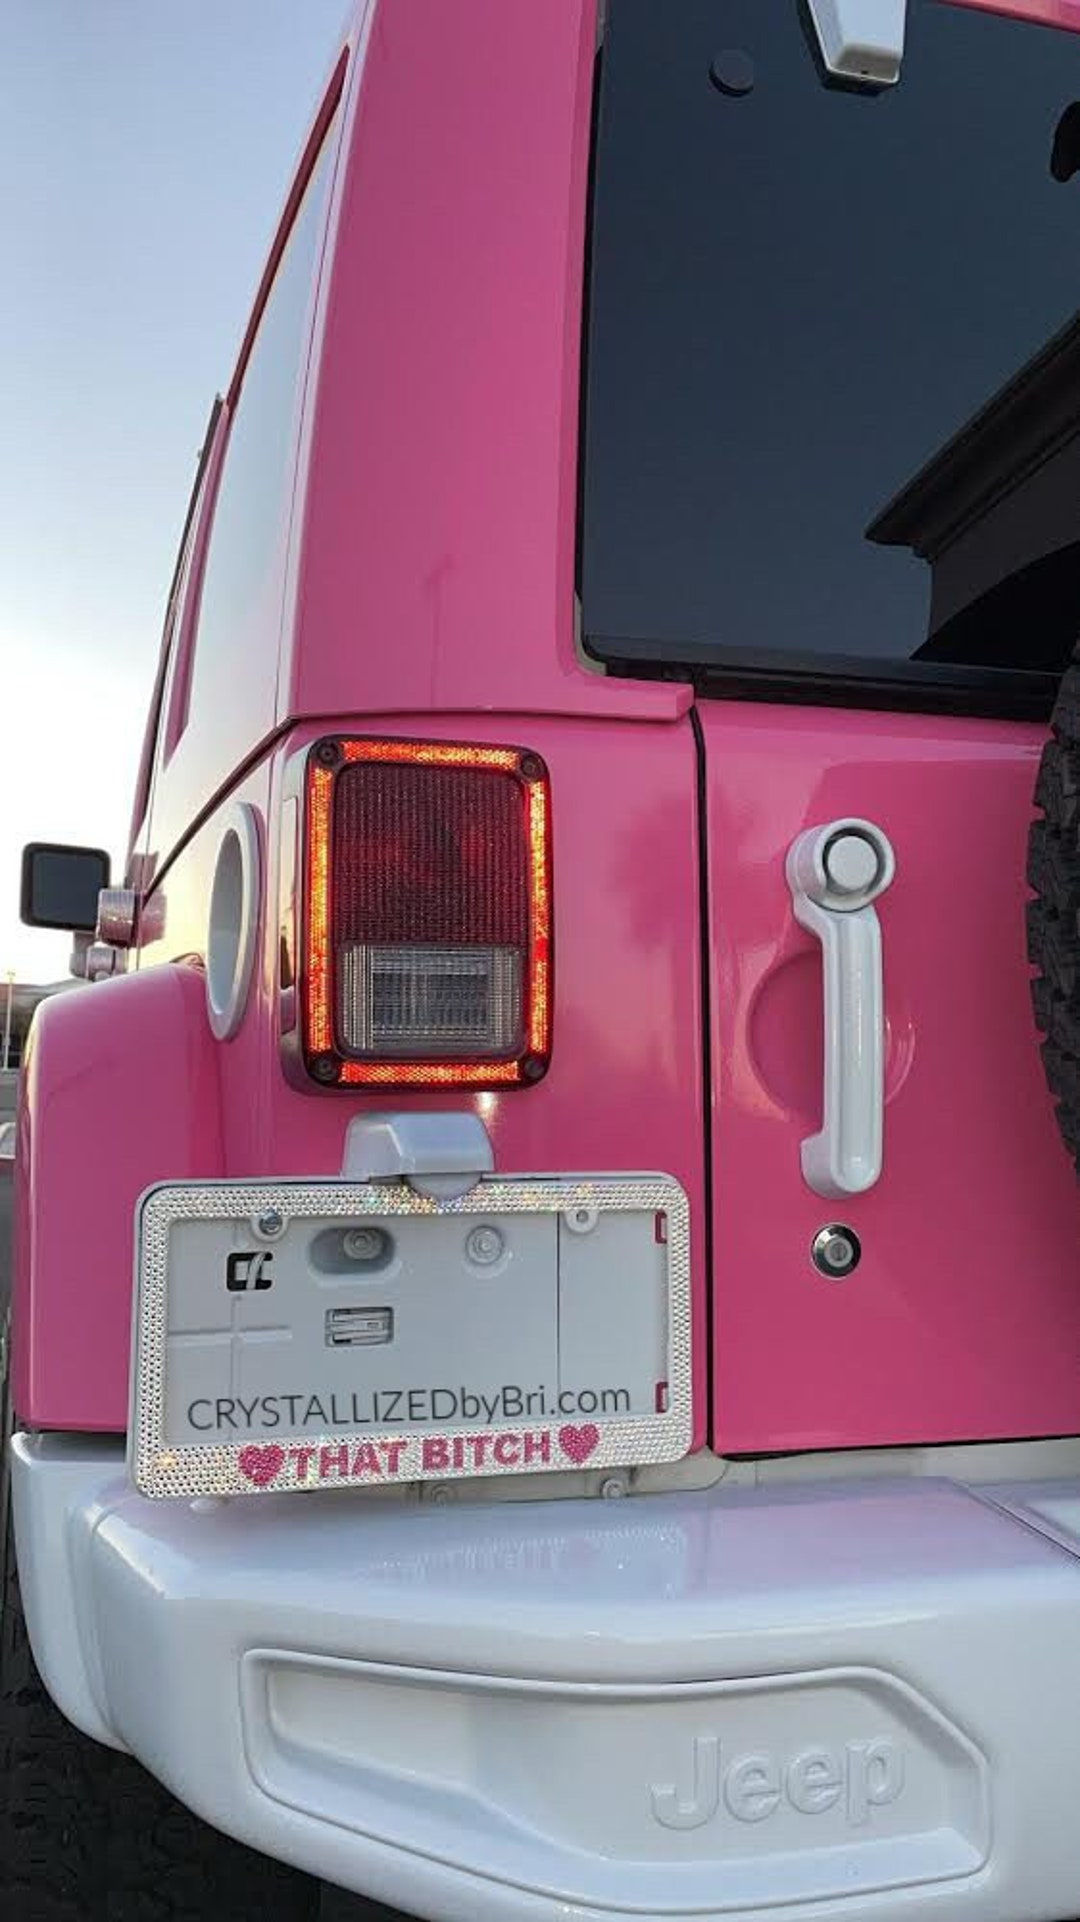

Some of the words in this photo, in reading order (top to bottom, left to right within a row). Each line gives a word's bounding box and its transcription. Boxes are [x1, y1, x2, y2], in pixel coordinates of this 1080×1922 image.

[287, 1440, 408, 1478] THAT
[421, 1432, 550, 1471] BITCH
[650, 1736, 906, 1830] Jeep
